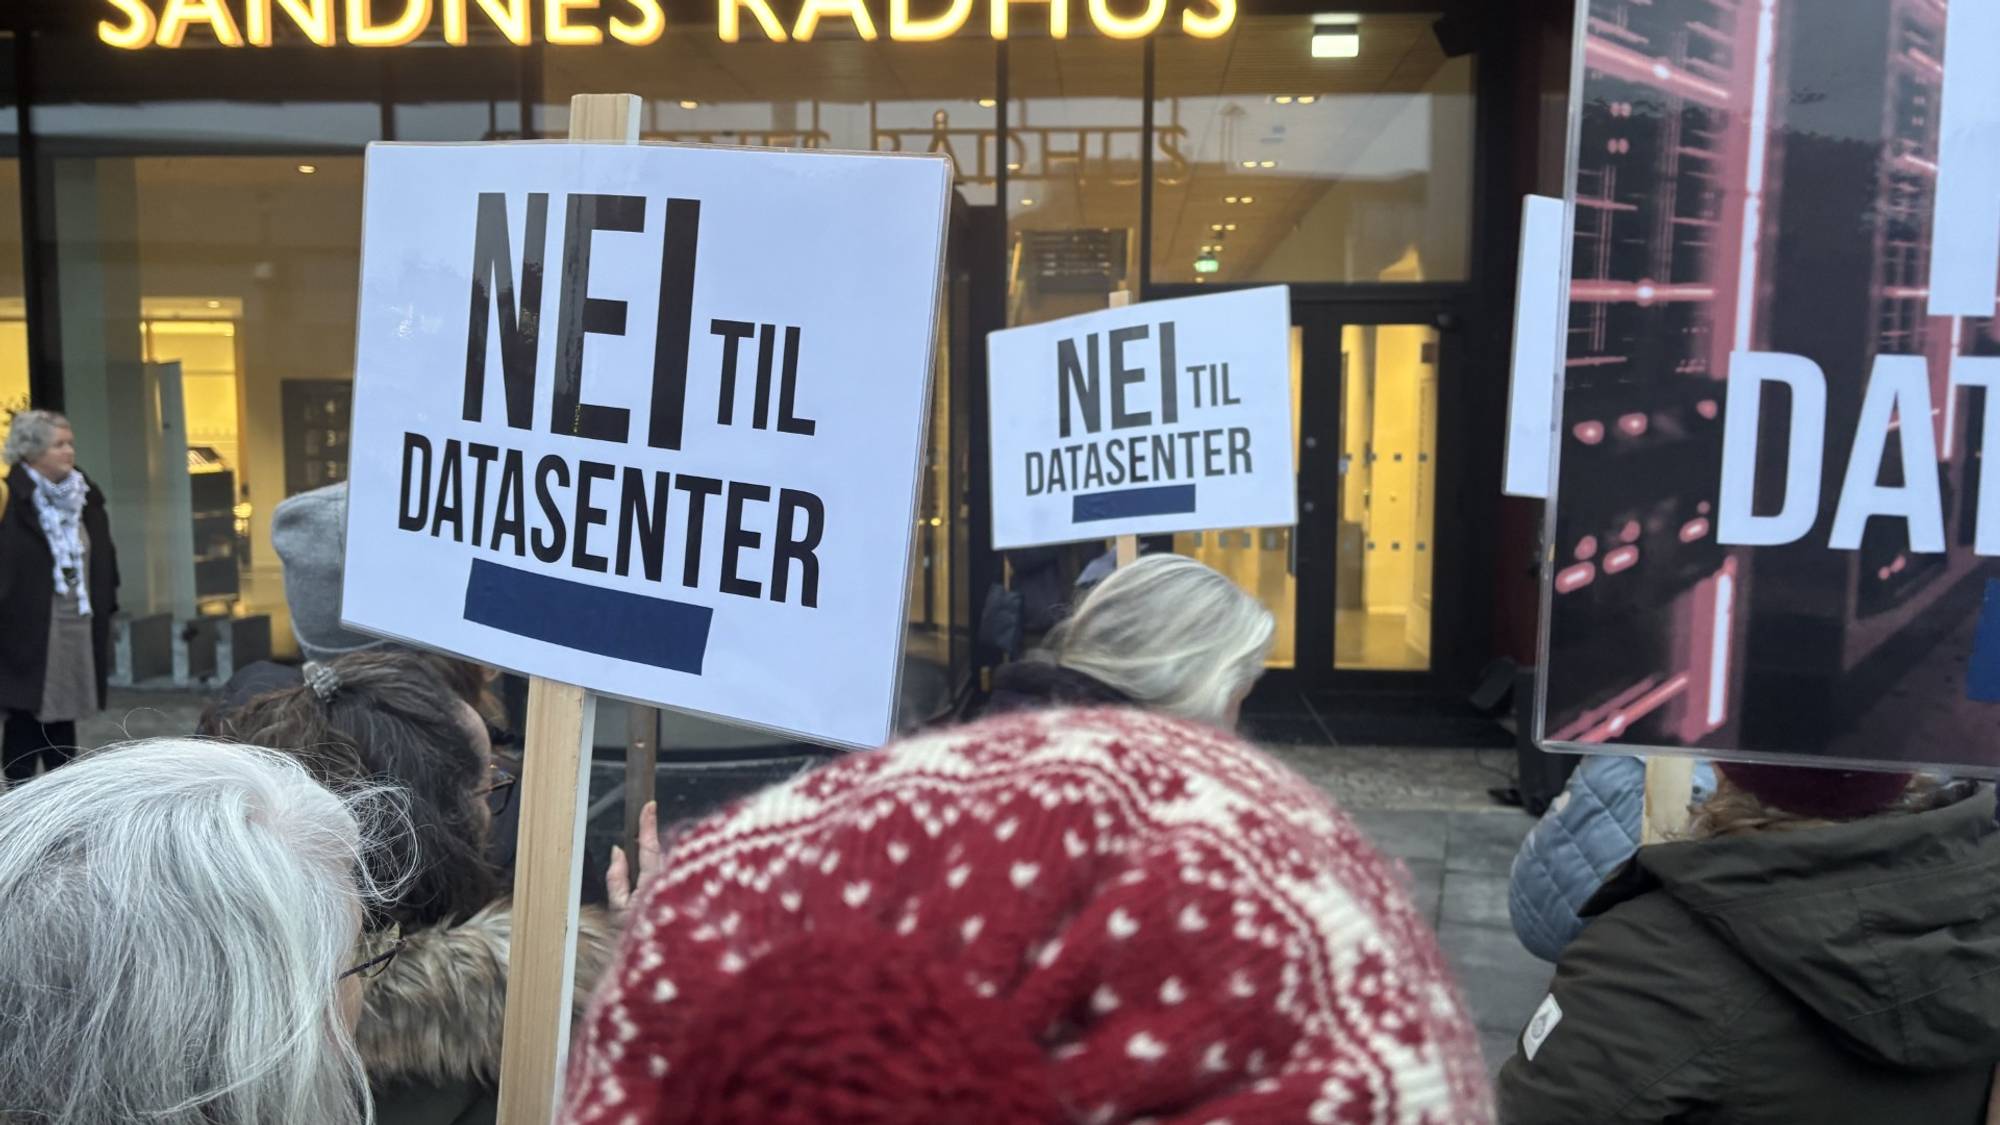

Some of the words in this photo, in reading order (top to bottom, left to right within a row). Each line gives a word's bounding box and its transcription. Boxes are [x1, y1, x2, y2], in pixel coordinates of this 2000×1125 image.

[98, 0, 665, 49] SANDNES
[463, 192, 701, 451] NEI
[711, 319, 816, 436] TIL
[1057, 321, 1178, 438] NEI
[1186, 362, 1241, 408] TIL
[399, 432, 826, 608] DATASENTER
[1025, 427, 1253, 496] DATASENTER
[1717, 351, 2000, 556] DAT
